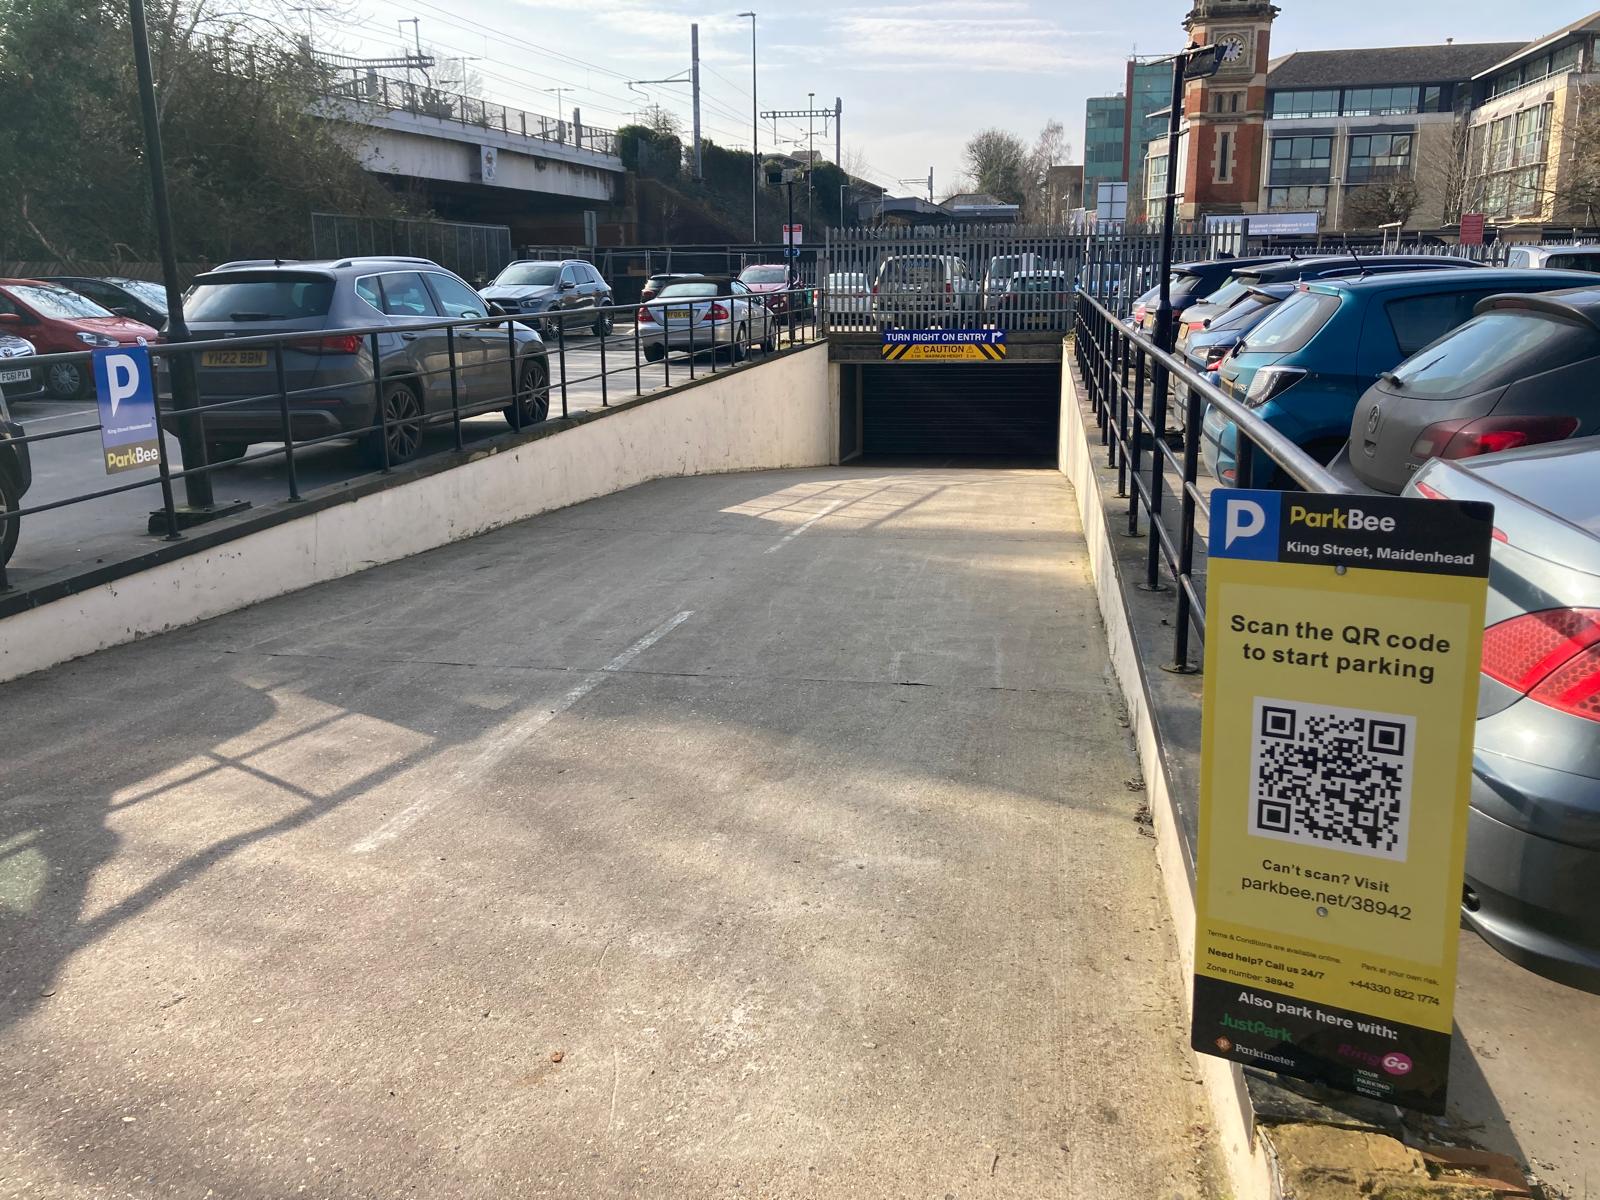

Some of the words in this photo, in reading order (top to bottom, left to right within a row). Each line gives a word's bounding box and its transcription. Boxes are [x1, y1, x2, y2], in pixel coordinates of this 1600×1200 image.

[886, 333, 911, 341] TURN
[913, 333, 940, 341] RIGHT
[941, 333, 956, 341] ON
[957, 333, 987, 341] ENTRY
[923, 345, 965, 353] CAUTION
[106, 354, 140, 417] P
[107, 447, 159, 468] ParkBee
[1225, 499, 1266, 550] P
[1290, 505, 1396, 532] ParkBee
[1286, 541, 1319, 556] King
[1322, 543, 1373, 560] Street,
[1376, 547, 1475, 565] Maidenhead
[1230, 614, 1289, 637] Scan
[1296, 621, 1334, 641] the
[1342, 625, 1380, 647] QR
[1386, 633, 1451, 654] code
[1242, 642, 1266, 661] to
[1272, 647, 1329, 668] start
[1336, 654, 1435, 684] parking
[1262, 859, 1301, 876] Can't
[1304, 868, 1350, 885] scan?
[1354, 876, 1390, 893] Visit
[1241, 877, 1412, 921] parkbee.net/38942
[1207, 929, 1228, 939] Terms
[1206, 962, 1227, 974] Zone
[1228, 968, 1262, 981] number:
[1264, 976, 1295, 989] 38942
[1207, 946, 1234, 960] Need
[1235, 952, 1264, 966] help?
[1265, 960, 1285, 971] Call
[1286, 965, 1299, 974] us
[1300, 968, 1325, 980] 24/7
[1349, 980, 1391, 995] +44330
[1393, 988, 1415, 1000] 822
[1416, 993, 1441, 1007] 1774
[1219, 1012, 1294, 1041] JustPark
[1238, 991, 1273, 1009] Also
[1276, 1002, 1312, 1019] park
[1315, 1009, 1354, 1029] here
[1357, 1022, 1398, 1040] with:
[1235, 1043, 1296, 1067] Parkimeter
[1356, 1077, 1390, 1091] PARKING
[1357, 1069, 1379, 1079] YOUR
[1356, 1086, 1382, 1097] SPACE
